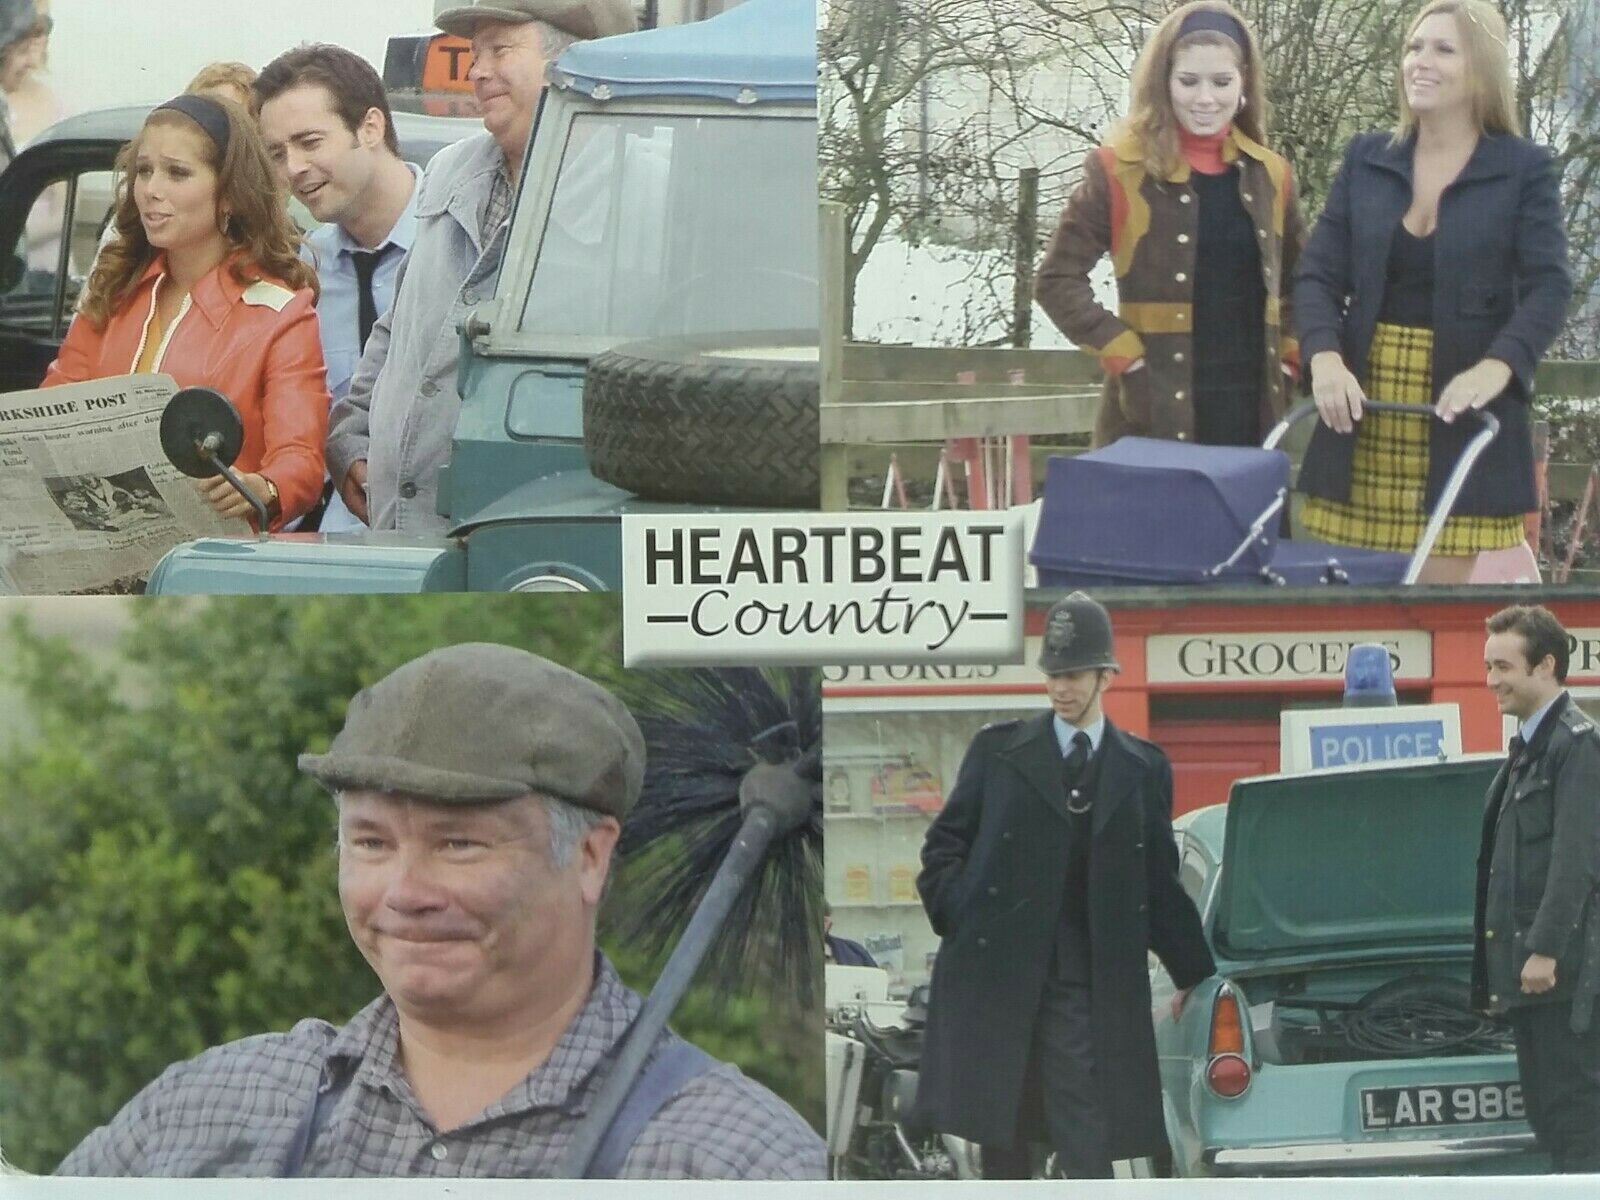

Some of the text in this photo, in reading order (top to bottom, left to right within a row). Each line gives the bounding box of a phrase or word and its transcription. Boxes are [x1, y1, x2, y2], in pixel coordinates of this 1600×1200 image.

[439, 46, 474, 81] T
[83, 392, 128, 411] POST
[77, 425, 113, 437] warning
[117, 420, 138, 431] after
[144, 415, 162, 425] dea
[645, 525, 1004, 585] HEARTBEAT
[1178, 638, 1401, 677] GROCES
[1320, 732, 1433, 768] POLICE
[1366, 1089, 1443, 1127] LAR
